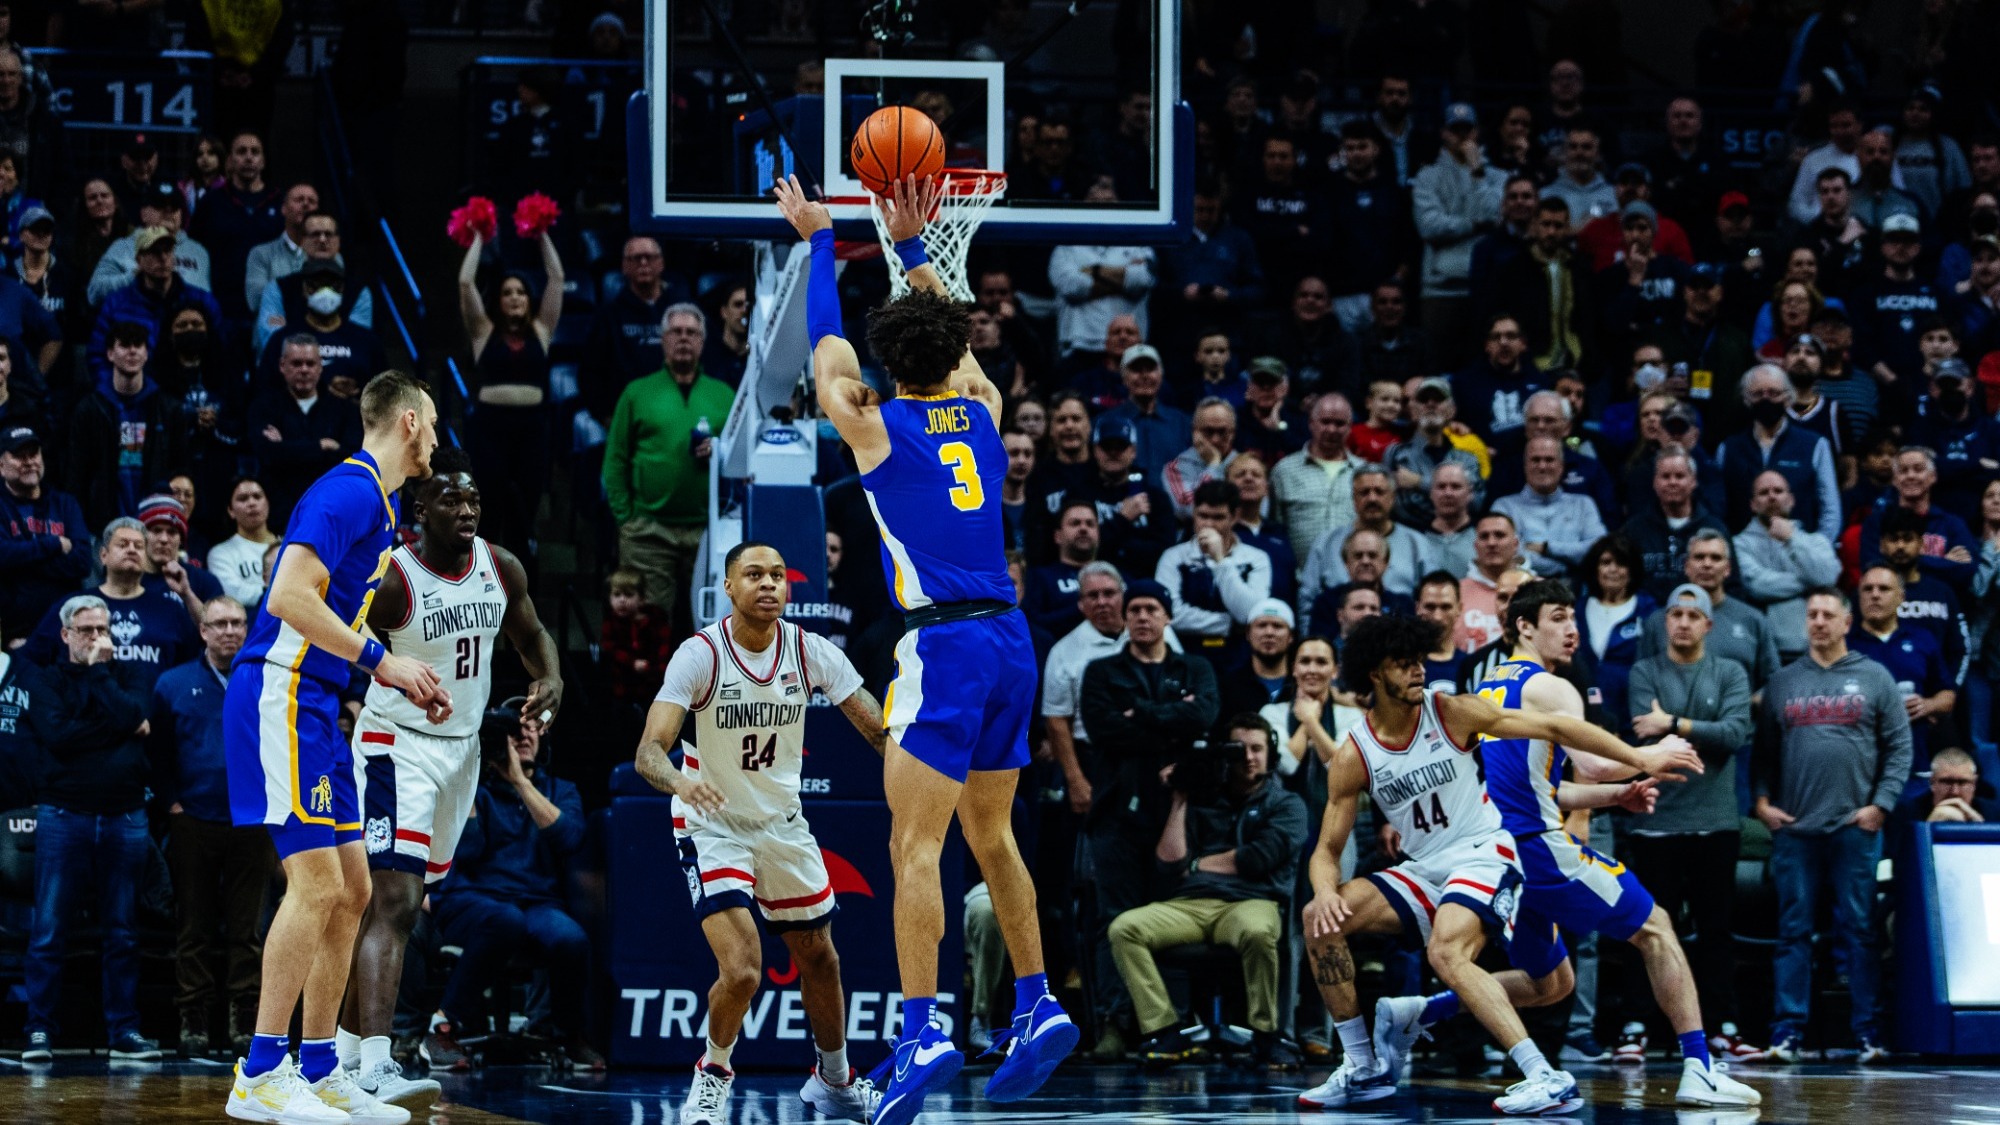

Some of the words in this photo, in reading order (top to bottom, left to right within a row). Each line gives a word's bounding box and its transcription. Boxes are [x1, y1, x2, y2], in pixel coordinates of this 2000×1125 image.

[106, 80, 198, 127] 114
[1876, 295, 1938, 312] UCONN
[925, 405, 970, 435] JONES
[938, 441, 985, 512] 3
[422, 601, 502, 642] CONNECTICUT
[456, 635, 480, 680] 21
[716, 702, 803, 729] CONNECTICUT
[742, 733, 777, 771] 24
[1377, 758, 1458, 806] CONNECTICUT
[1412, 792, 1448, 833] 44
[620, 988, 955, 1040] TRVEERS
